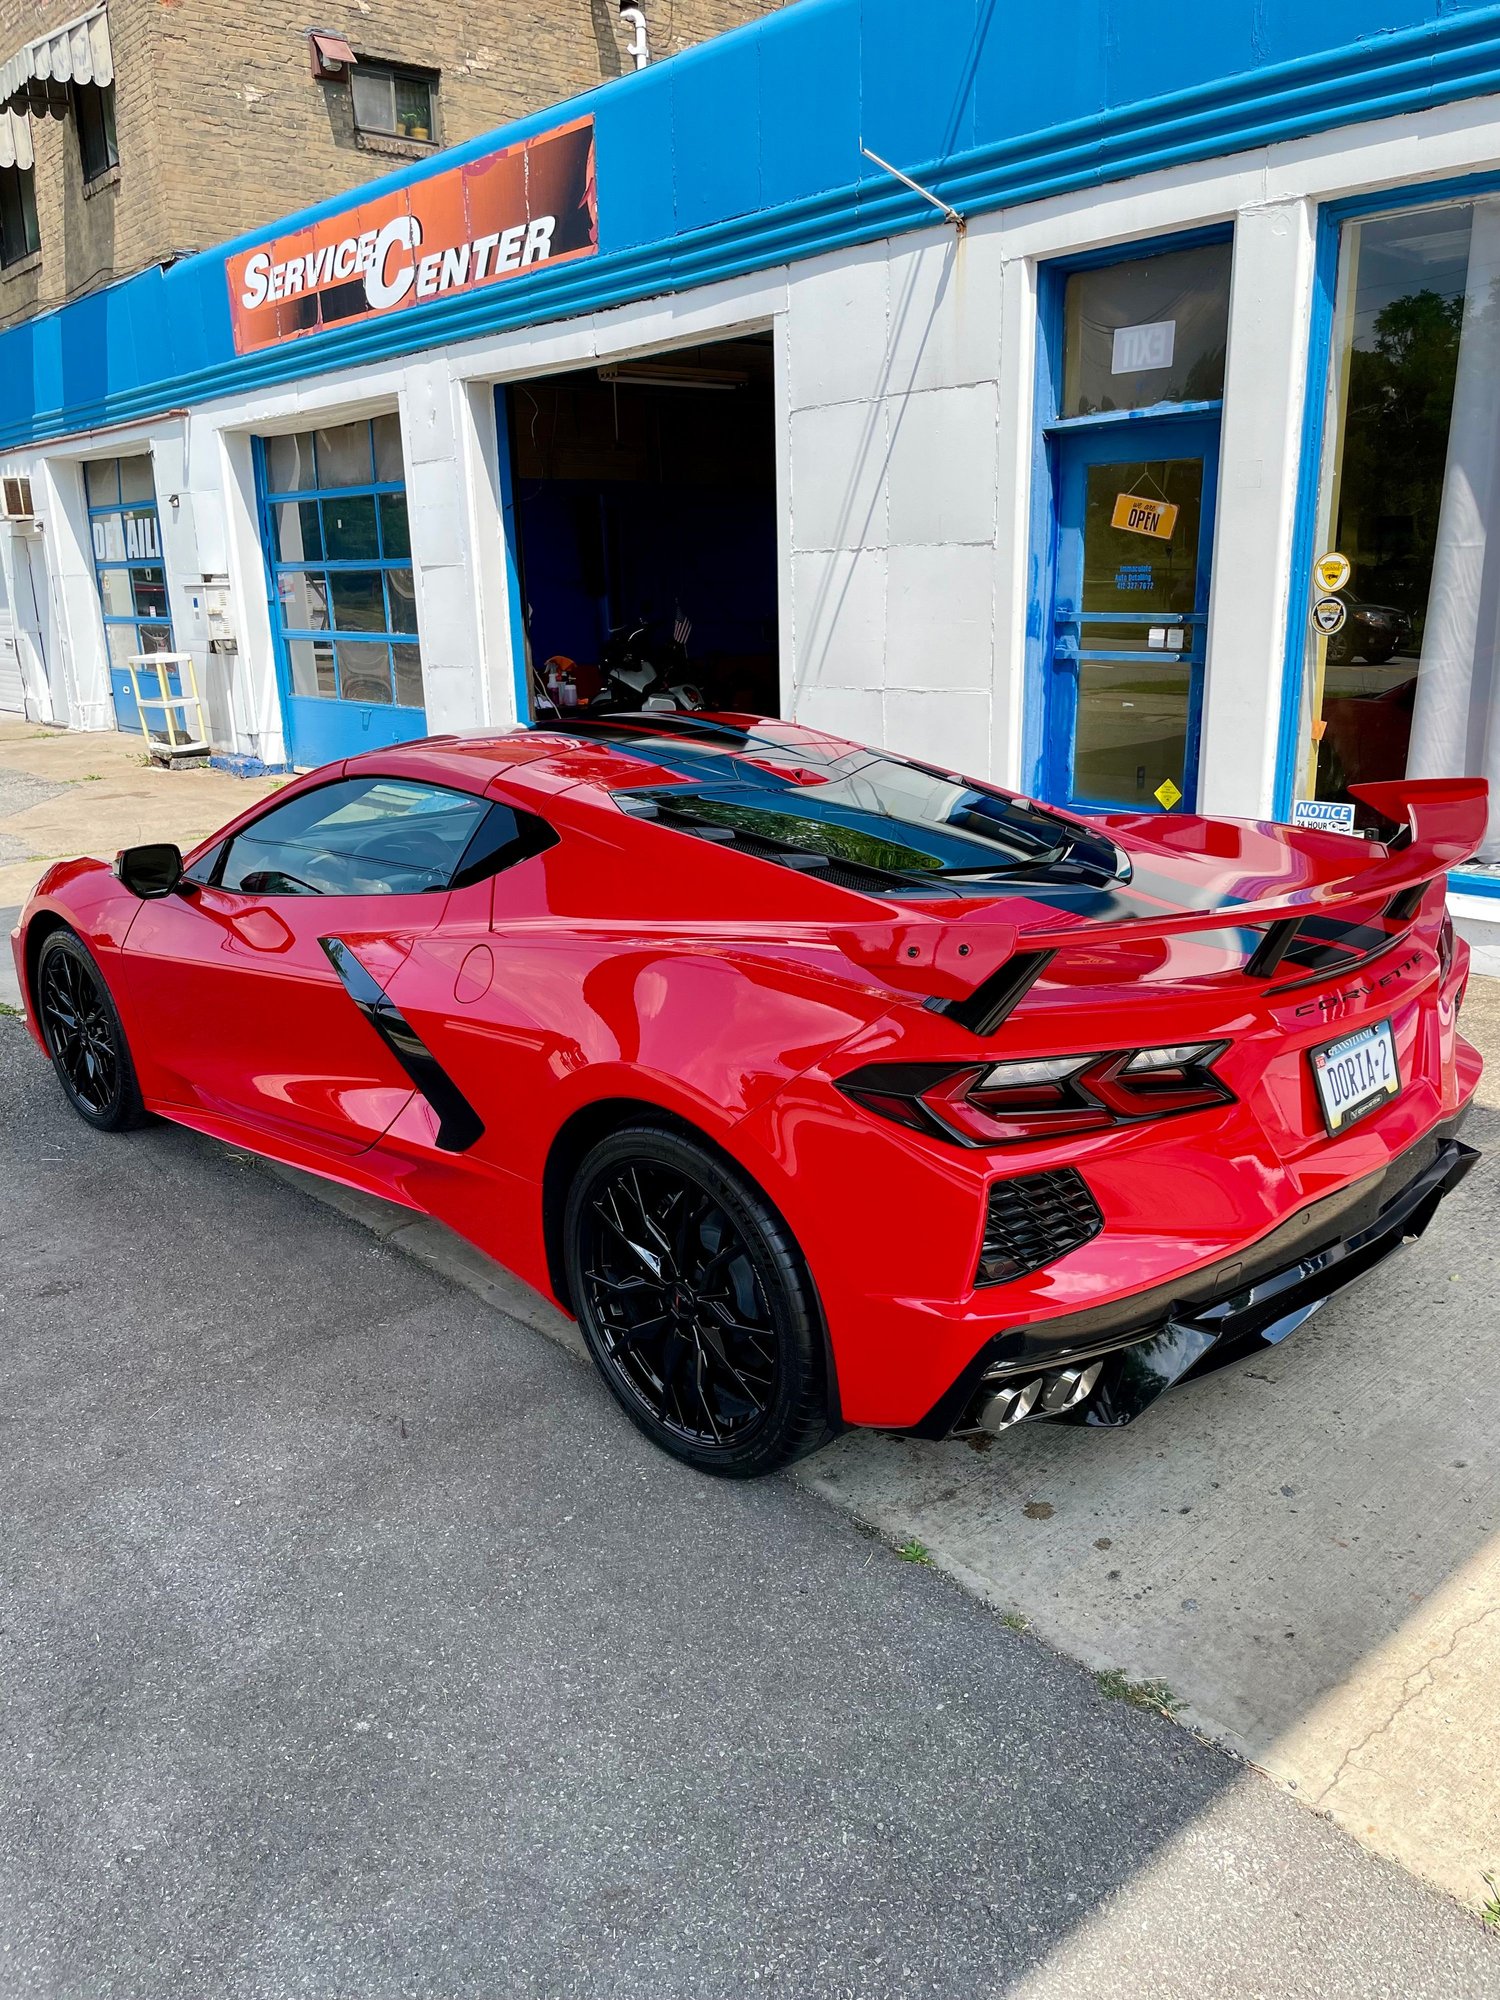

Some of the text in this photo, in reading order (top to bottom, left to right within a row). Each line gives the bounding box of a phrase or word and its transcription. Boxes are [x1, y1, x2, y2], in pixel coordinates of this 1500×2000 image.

[242, 215, 556, 309] SERVICE CENTER
[1128, 509, 1160, 532] OPEN
[1297, 803, 1349, 820] NOTICE
[1308, 821, 1327, 830] HOUR
[1295, 950, 1424, 1018] CORVETTE
[1327, 1039, 1390, 1107] DORIA-2
